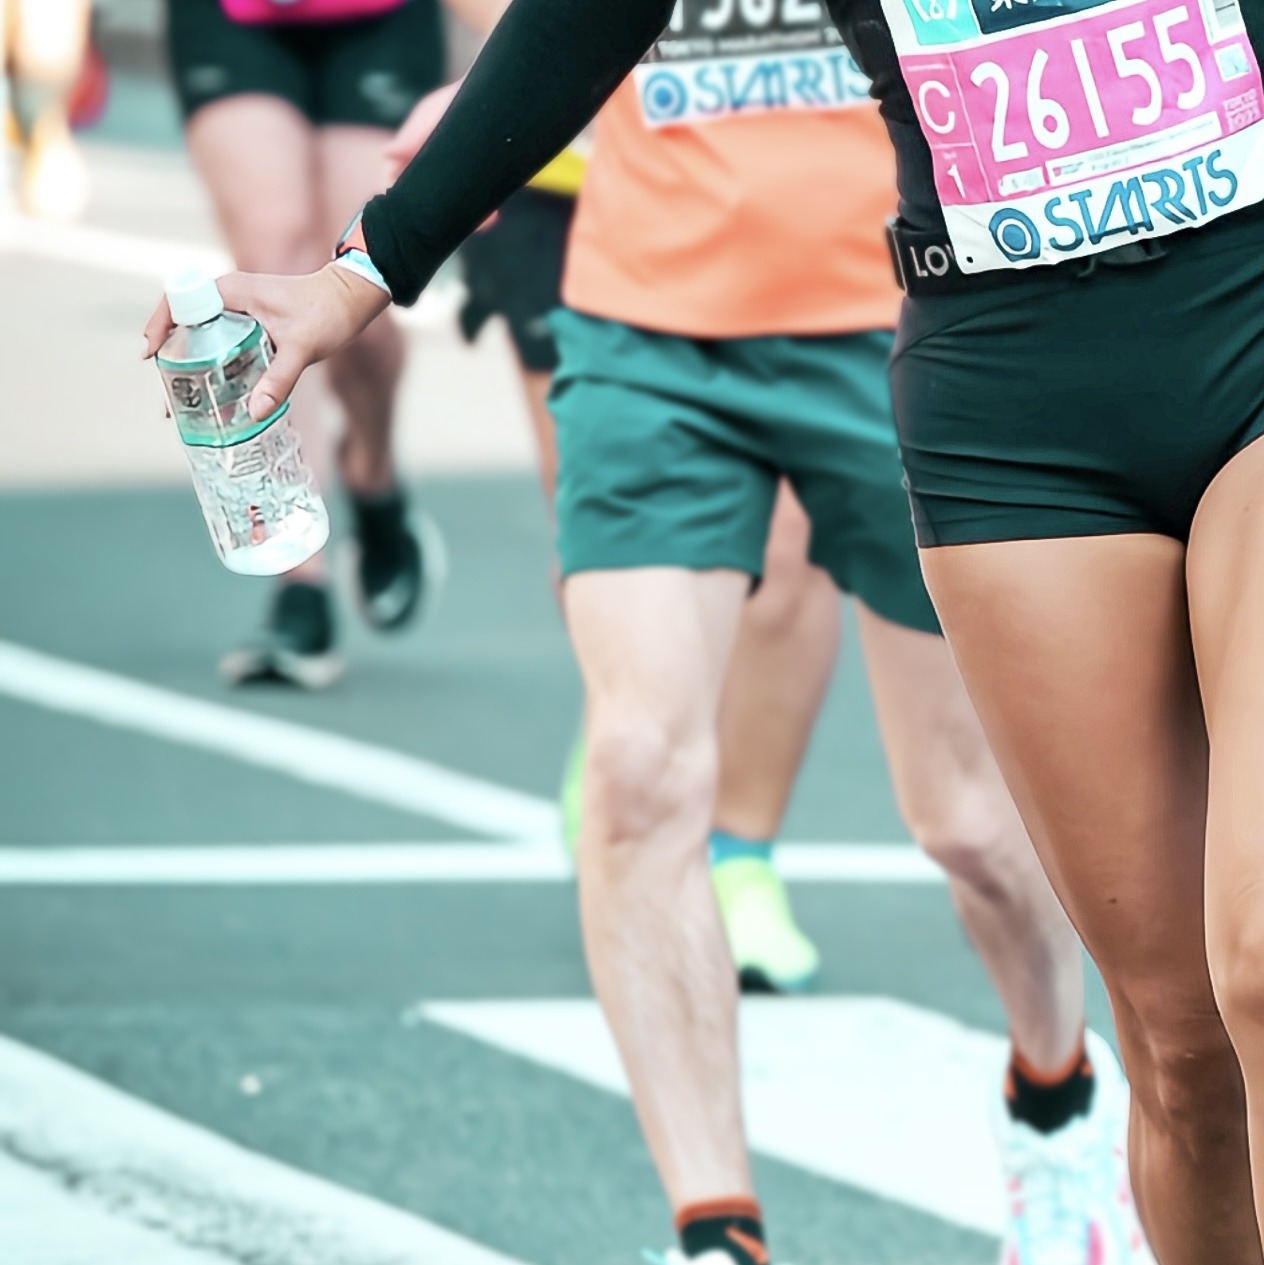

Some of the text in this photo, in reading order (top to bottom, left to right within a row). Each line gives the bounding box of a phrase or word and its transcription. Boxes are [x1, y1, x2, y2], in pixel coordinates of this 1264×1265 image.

[918, 80, 955, 134] C
[970, 5, 1207, 164] 26155
[947, 163, 966, 199] 1
[1044, 149, 1238, 252] STARTS
